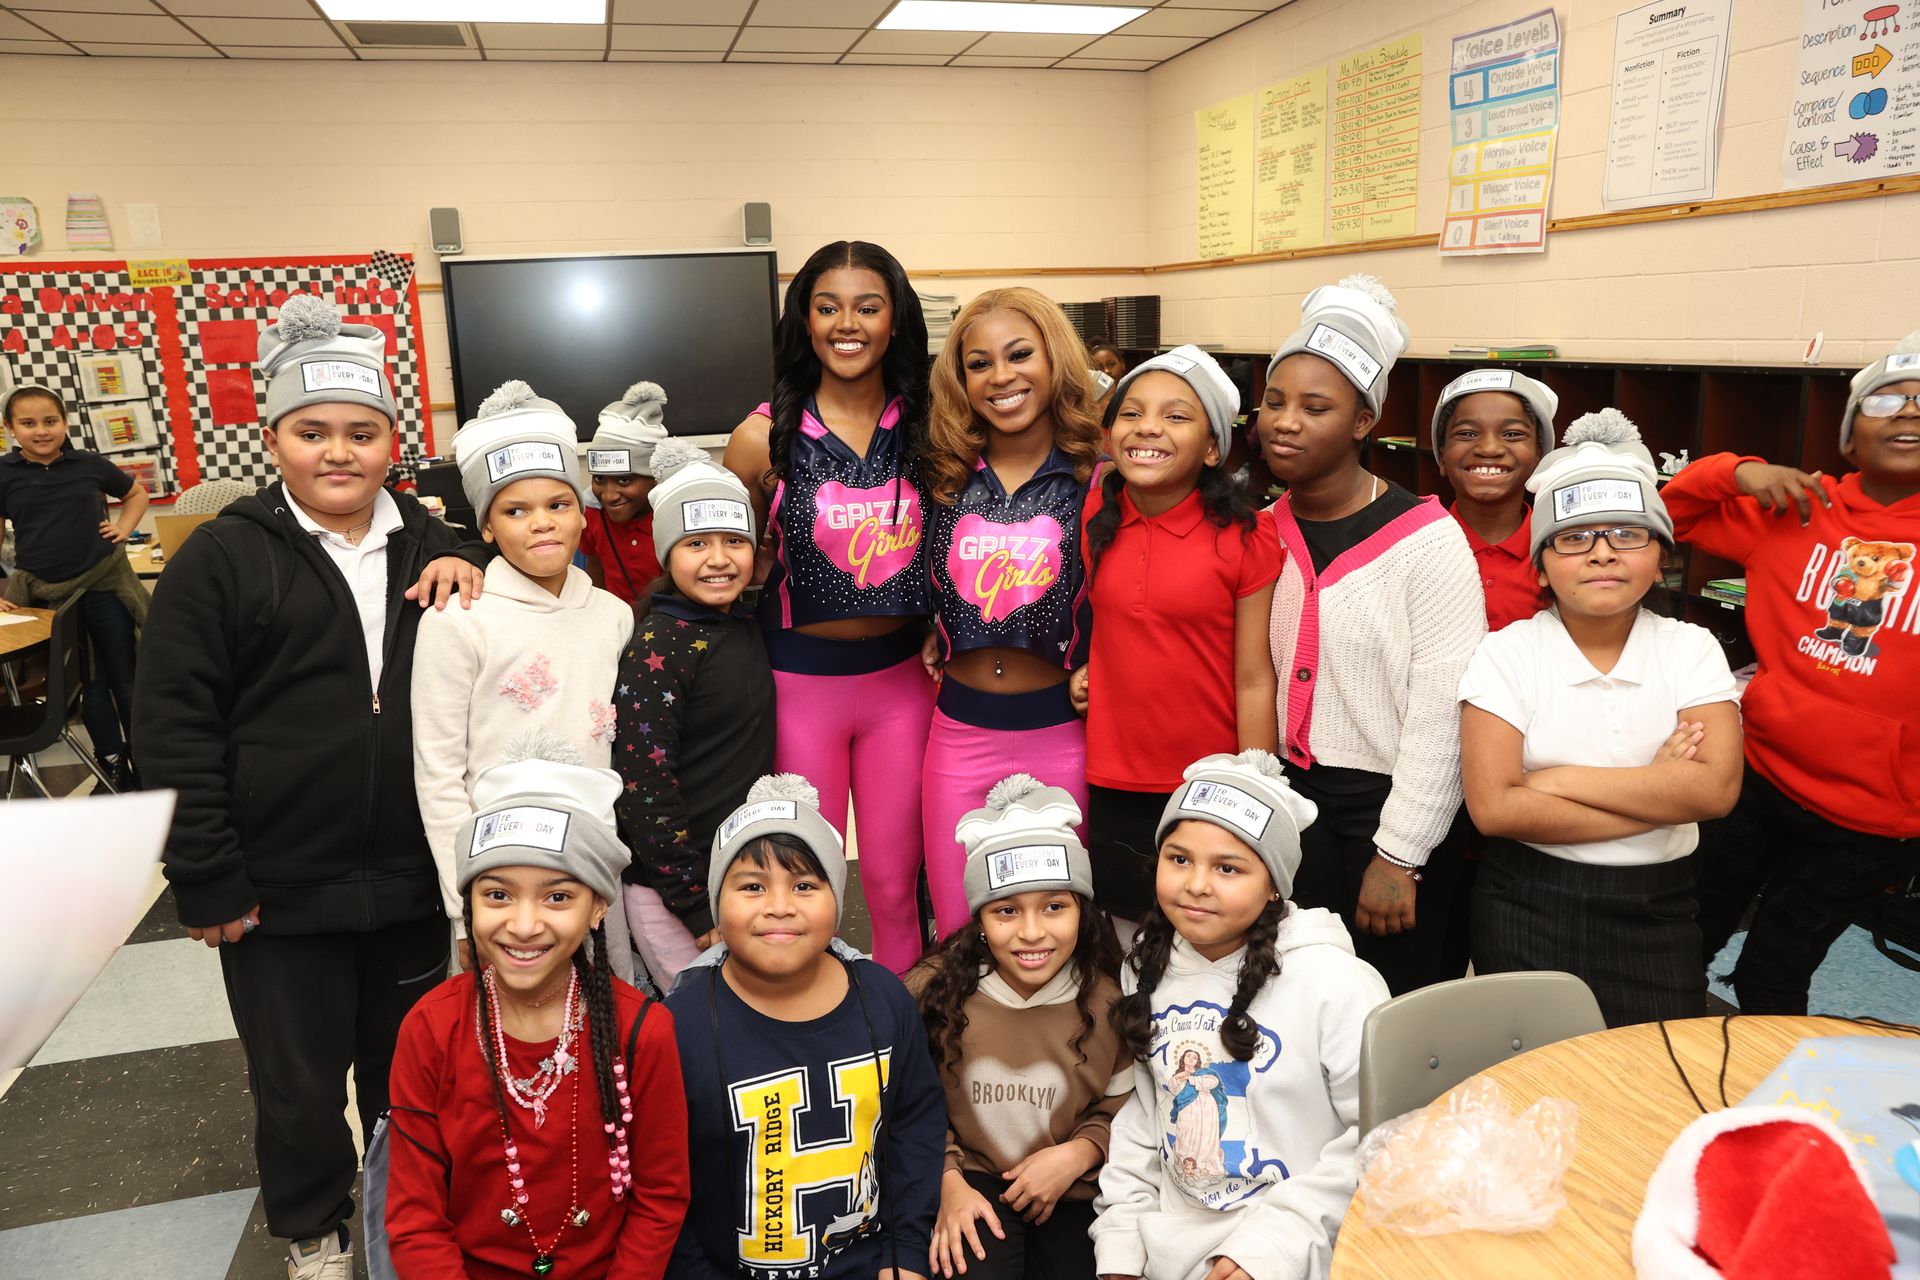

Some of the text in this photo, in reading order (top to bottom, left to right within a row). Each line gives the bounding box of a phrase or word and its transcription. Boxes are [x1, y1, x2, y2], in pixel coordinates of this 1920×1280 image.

[1649, 6, 1687, 25] Summary
[1461, 22, 1550, 61] Voice Levels
[1802, 24, 1857, 50] Description
[1378, 43, 1409, 65] Schedule
[1677, 47, 1701, 60] Fiction
[1490, 65, 1524, 84] Outside
[1624, 60, 1655, 74] Nonfiction
[1800, 64, 1846, 86] Sequence
[1464, 79, 1473, 100] 4
[1488, 99, 1554, 121] Loud Proud Voice
[1793, 90, 1845, 117] Compare/
[1464, 117, 1473, 138] 3
[1797, 110, 1836, 129] Contrast
[1484, 139, 1548, 160] Normal Voice
[1790, 135, 1830, 157] Cause &
[1459, 153, 1469, 174] 2
[1796, 153, 1824, 172] Effect
[1482, 179, 1541, 196] Whisper Voice
[1504, 217, 1530, 229] Voice
[137, 267, 172, 278] RACE IN
[39, 282, 153, 313] Driven
[333, 274, 399, 307] info
[1338, 343, 1371, 376] EVERY DAY
[332, 370, 355, 380] EVERY
[541, 451, 554, 460] DAY
[1583, 491, 1632, 501] EVERY DAY
[708, 510, 728, 519] EVERY
[848, 514, 920, 586] Girls
[959, 535, 1053, 563] GRIZZ
[975, 549, 1055, 618] Girls
[1797, 635, 1878, 676] CHAMPION
[1213, 795, 1260, 822] EVERY DAY
[498, 821, 554, 835] EVERY DAY
[1015, 858, 1060, 870] EVERY DAY
[972, 1080, 1056, 1112] BROOKLYN
[764, 1092, 783, 1253] HICKORY RIDGE
[1226, 1182, 1240, 1196] de
